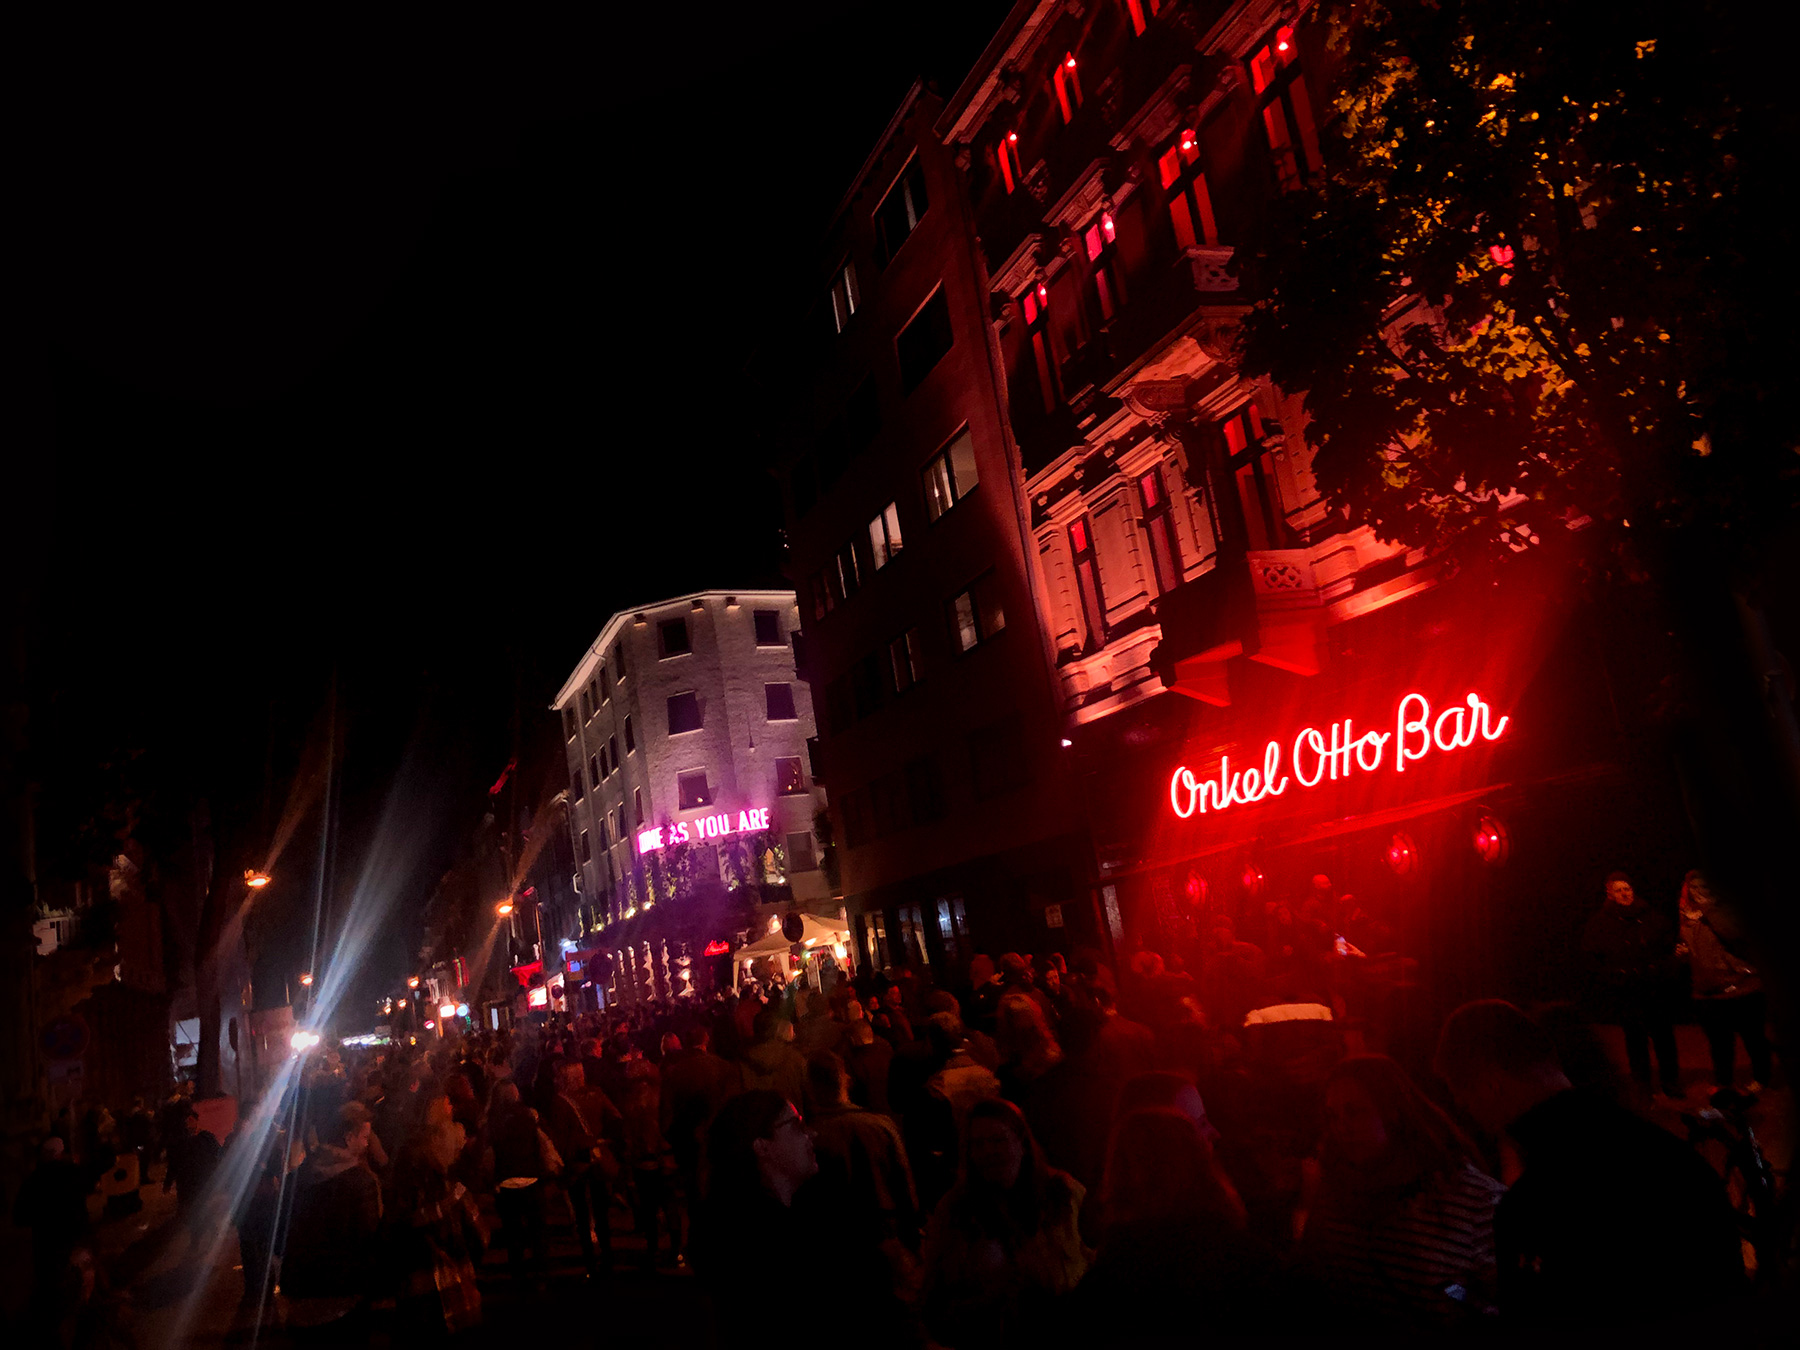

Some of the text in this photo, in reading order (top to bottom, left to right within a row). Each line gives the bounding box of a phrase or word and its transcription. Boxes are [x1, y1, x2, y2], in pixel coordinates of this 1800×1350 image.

[1170, 693, 1509, 819] Onkel Otto Bar
[695, 814, 730, 838] YOU
[738, 808, 769, 831] ARE
